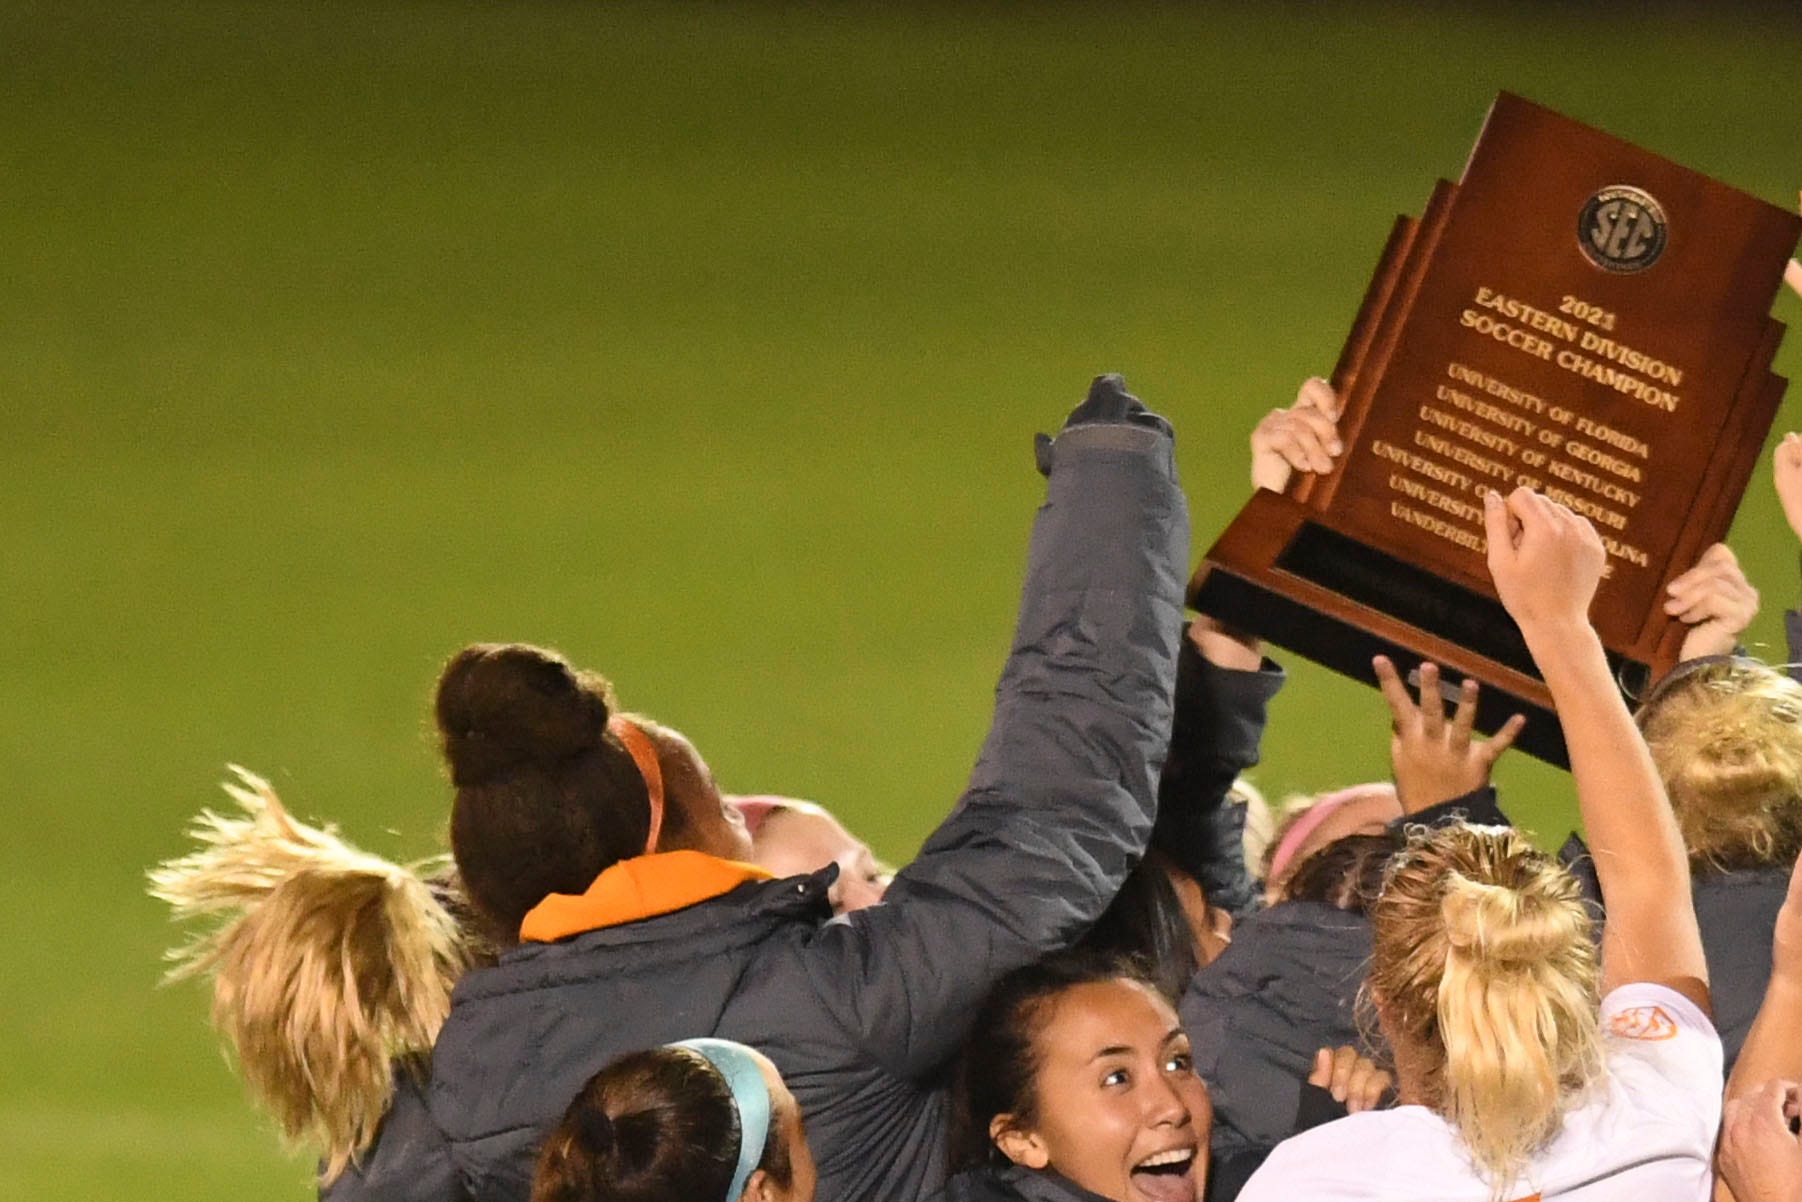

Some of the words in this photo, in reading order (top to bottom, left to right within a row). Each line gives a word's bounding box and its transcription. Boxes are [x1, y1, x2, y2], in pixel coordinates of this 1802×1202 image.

[1591, 200, 1654, 259] SEC
[1459, 309, 1553, 360] SOCCER
[1556, 350, 1681, 412] CHAMPION
[1475, 286, 1580, 342] EASTERN
[1580, 331, 1683, 387] DIVISION
[1559, 295, 1617, 331] 2021
[1420, 405, 1520, 456] UNIVERSITY
[1521, 450, 1546, 468] OF
[1548, 460, 1641, 508] KENTUCKY
[1436, 384, 1537, 437] UNIVERSITY
[1538, 428, 1564, 448] OF
[1565, 440, 1642, 483] GEORGIA
[1448, 362, 1548, 415] UNIVERSITY
[1550, 406, 1575, 425] OF
[1575, 417, 1649, 459] FLORIDA
[1372, 440, 1472, 491] UNIVERSITY
[1600, 535, 1649, 567] OLINA
[1389, 473, 1484, 525] UNIVERSITY
[1414, 430, 1514, 481] UNIVERSITY
[1545, 485, 1628, 531] MISSOURI
